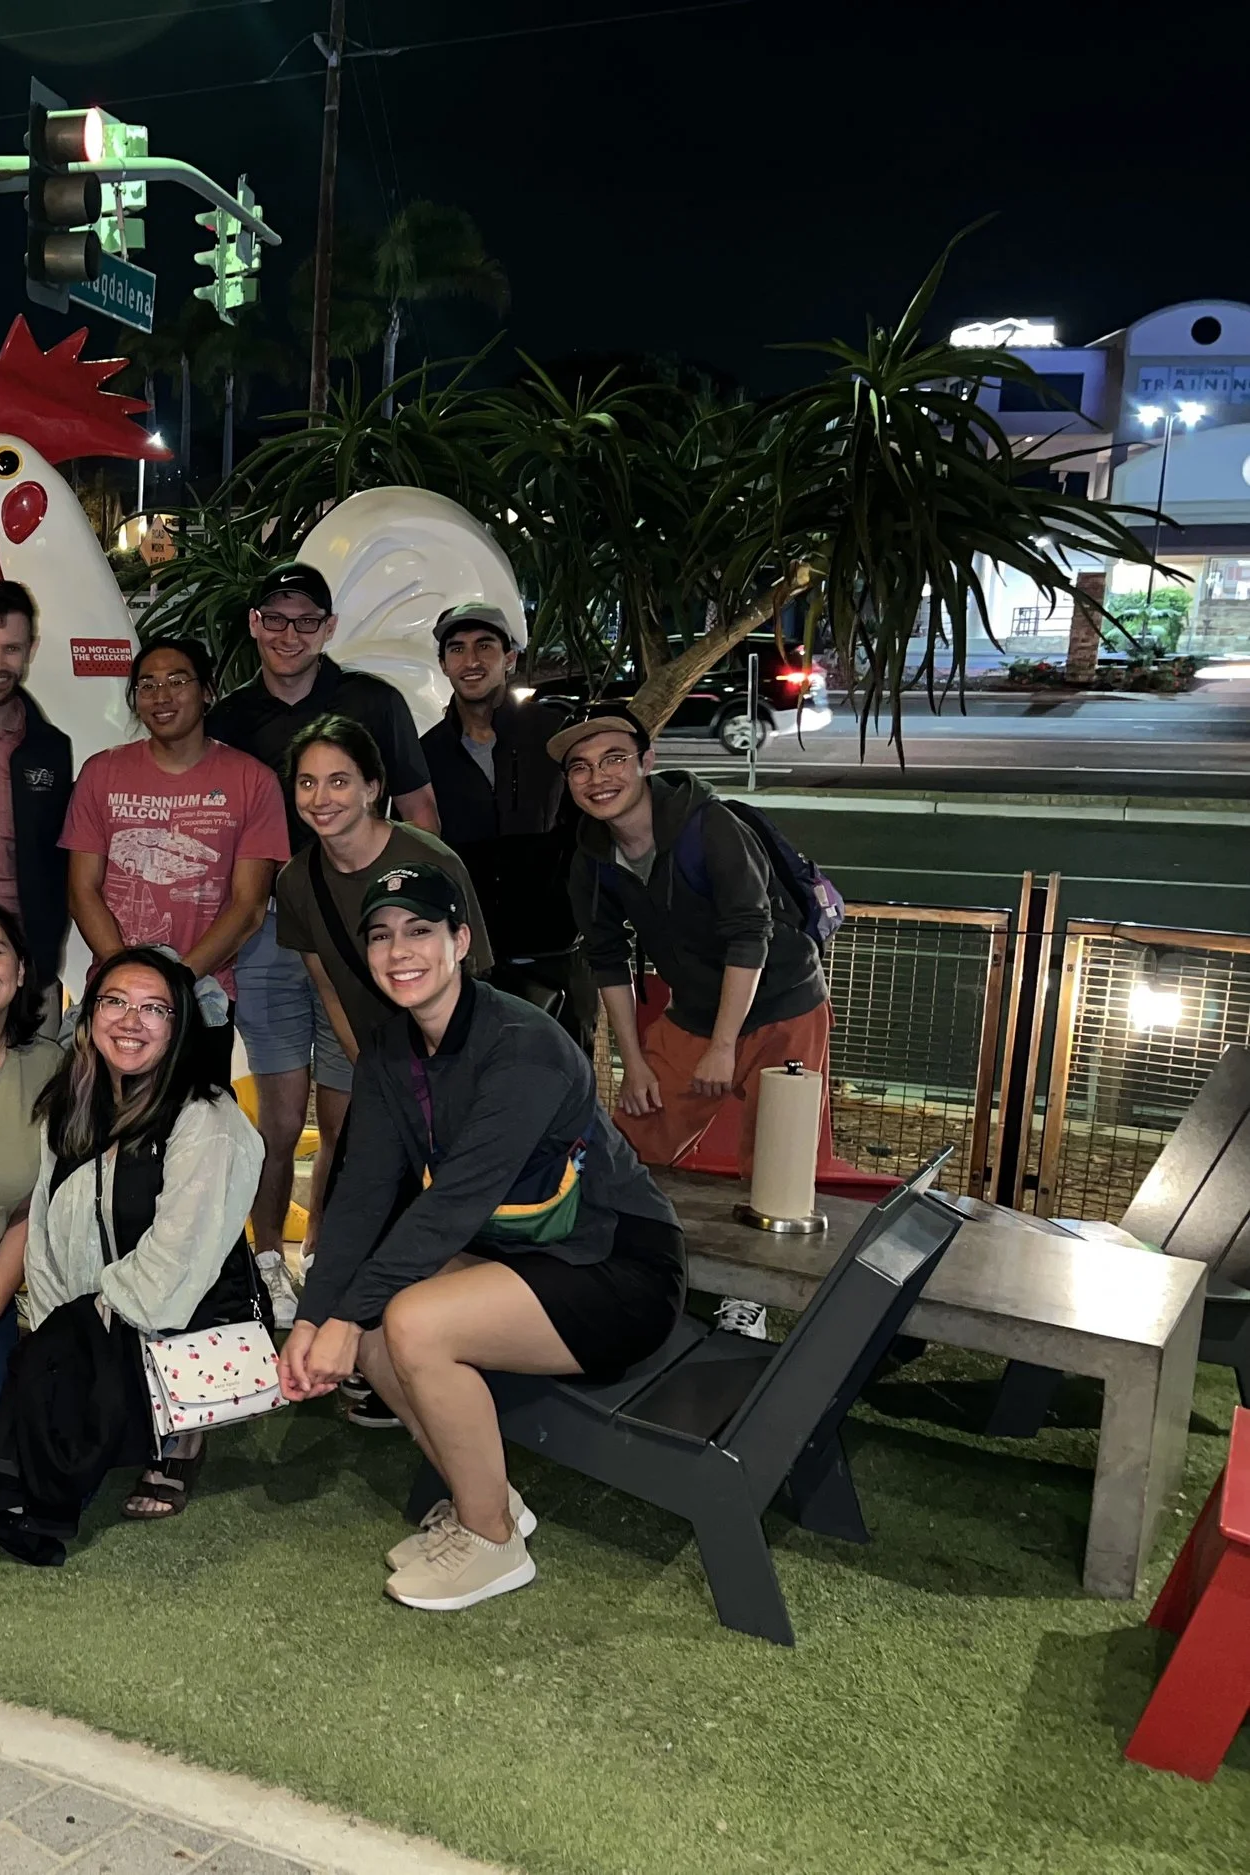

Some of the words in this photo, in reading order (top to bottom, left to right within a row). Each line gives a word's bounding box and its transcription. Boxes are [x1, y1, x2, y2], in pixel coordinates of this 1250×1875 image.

[89, 646, 108, 654] NOT
[108, 793, 201, 808] MILLENNIUM
[112, 806, 170, 820] FALCON
